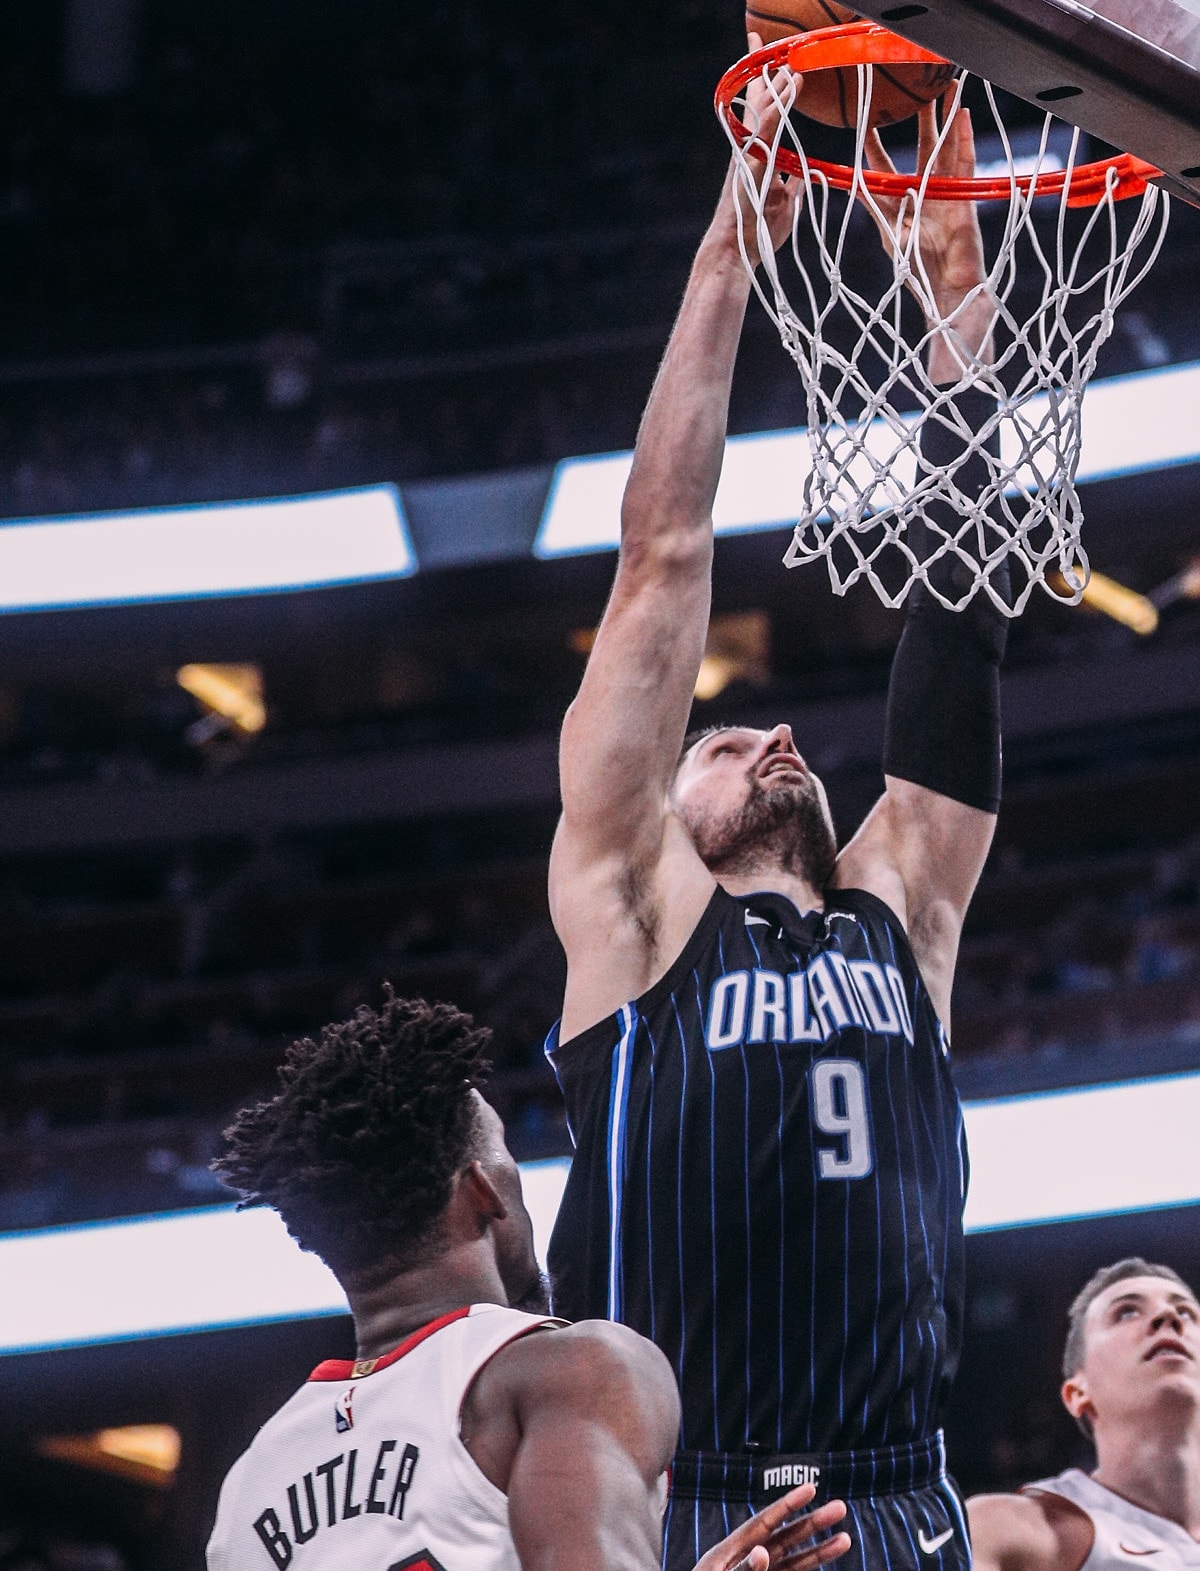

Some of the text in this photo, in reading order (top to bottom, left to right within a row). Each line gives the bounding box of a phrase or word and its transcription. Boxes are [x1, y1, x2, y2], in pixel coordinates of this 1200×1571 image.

[705, 950, 916, 1051] ORLANDO
[811, 1057, 875, 1181] 9
[253, 1439, 420, 1571] BUTLER
[763, 1464, 821, 1491] MAGIC
